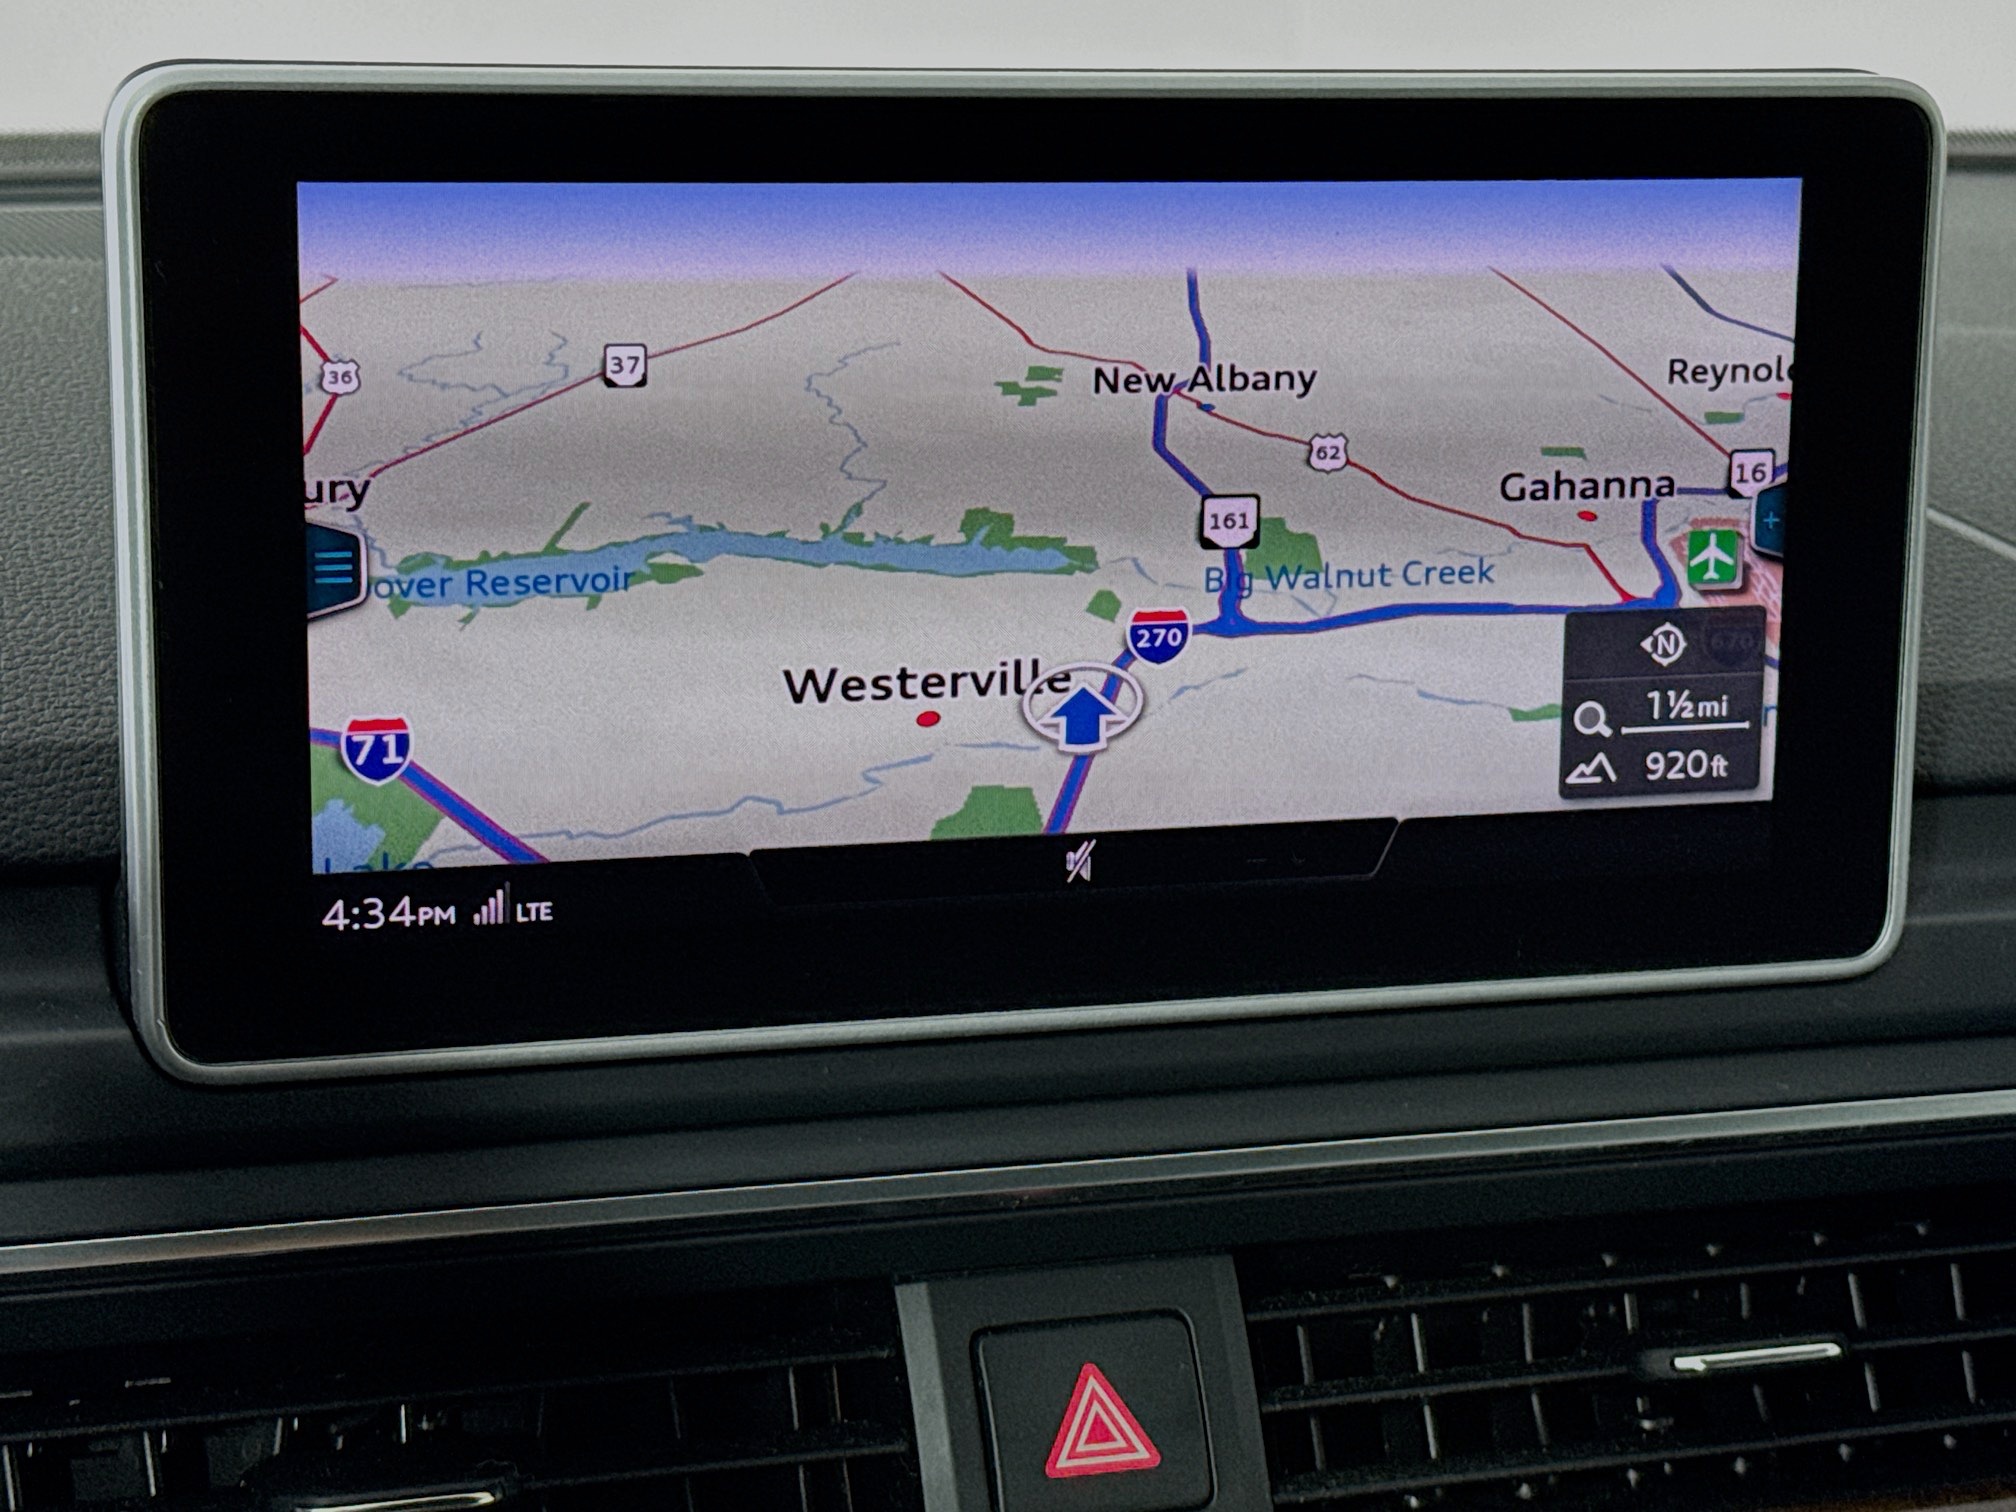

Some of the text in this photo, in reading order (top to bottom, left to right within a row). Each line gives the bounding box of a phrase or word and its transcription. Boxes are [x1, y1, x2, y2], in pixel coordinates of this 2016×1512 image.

[610, 355, 640, 375] 37
[328, 370, 352, 385] 36
[1094, 364, 1318, 398] New Albany
[1316, 445, 1341, 461] 62
[1736, 463, 1766, 483] 16
[1500, 470, 1675, 501] Gahanna
[1210, 513, 1249, 530] 161
[368, 565, 634, 599] over Reservoir
[1265, 564, 1392, 591] Walnut
[1402, 556, 1495, 587] Creek
[1136, 627, 1183, 649] 270
[783, 658, 1072, 704] Westerville
[352, 734, 404, 766] 71
[516, 902, 553, 922] LTE
